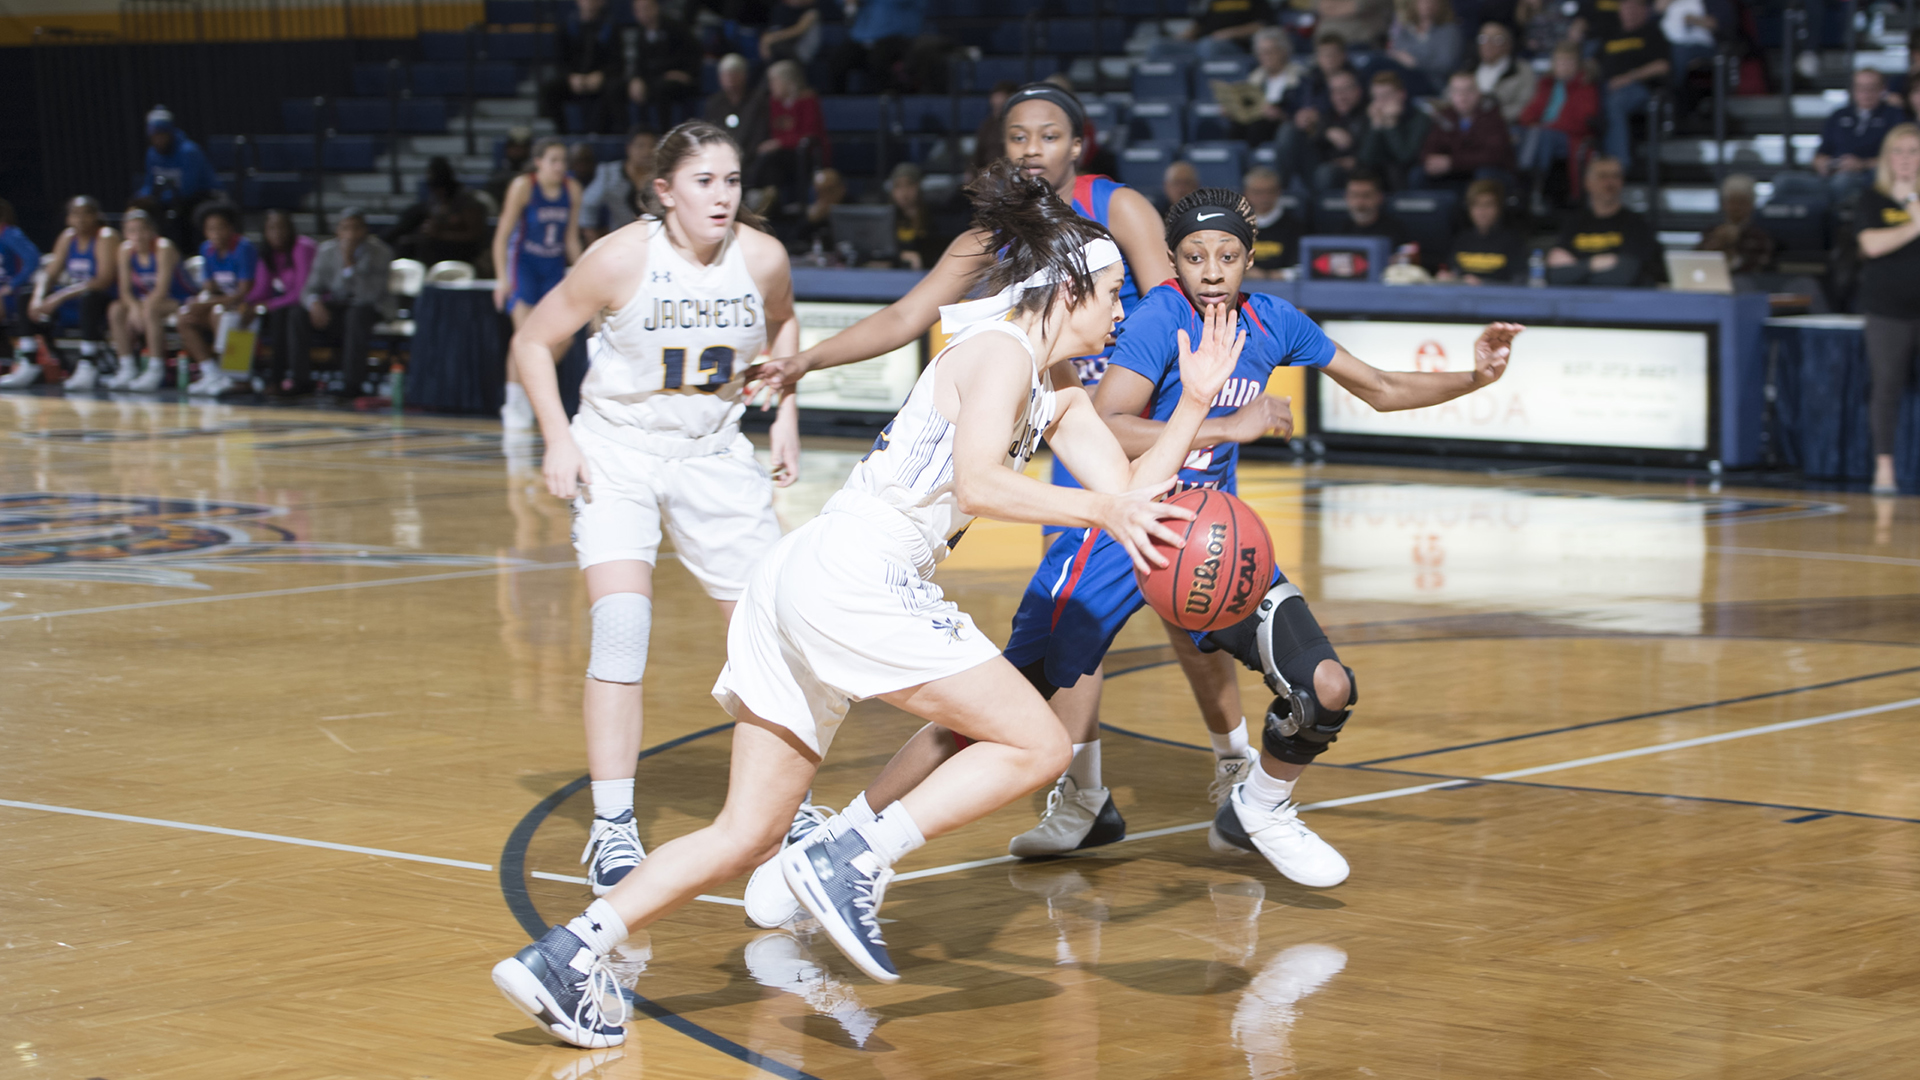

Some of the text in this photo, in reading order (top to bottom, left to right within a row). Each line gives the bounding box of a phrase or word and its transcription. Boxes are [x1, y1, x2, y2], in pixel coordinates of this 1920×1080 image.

[644, 293, 757, 331] JACKETS
[1209, 378, 1261, 408] HIO
[1332, 382, 1530, 426] RADA
[1184, 521, 1228, 615] Wilson
[1225, 547, 1256, 615] NCAA
